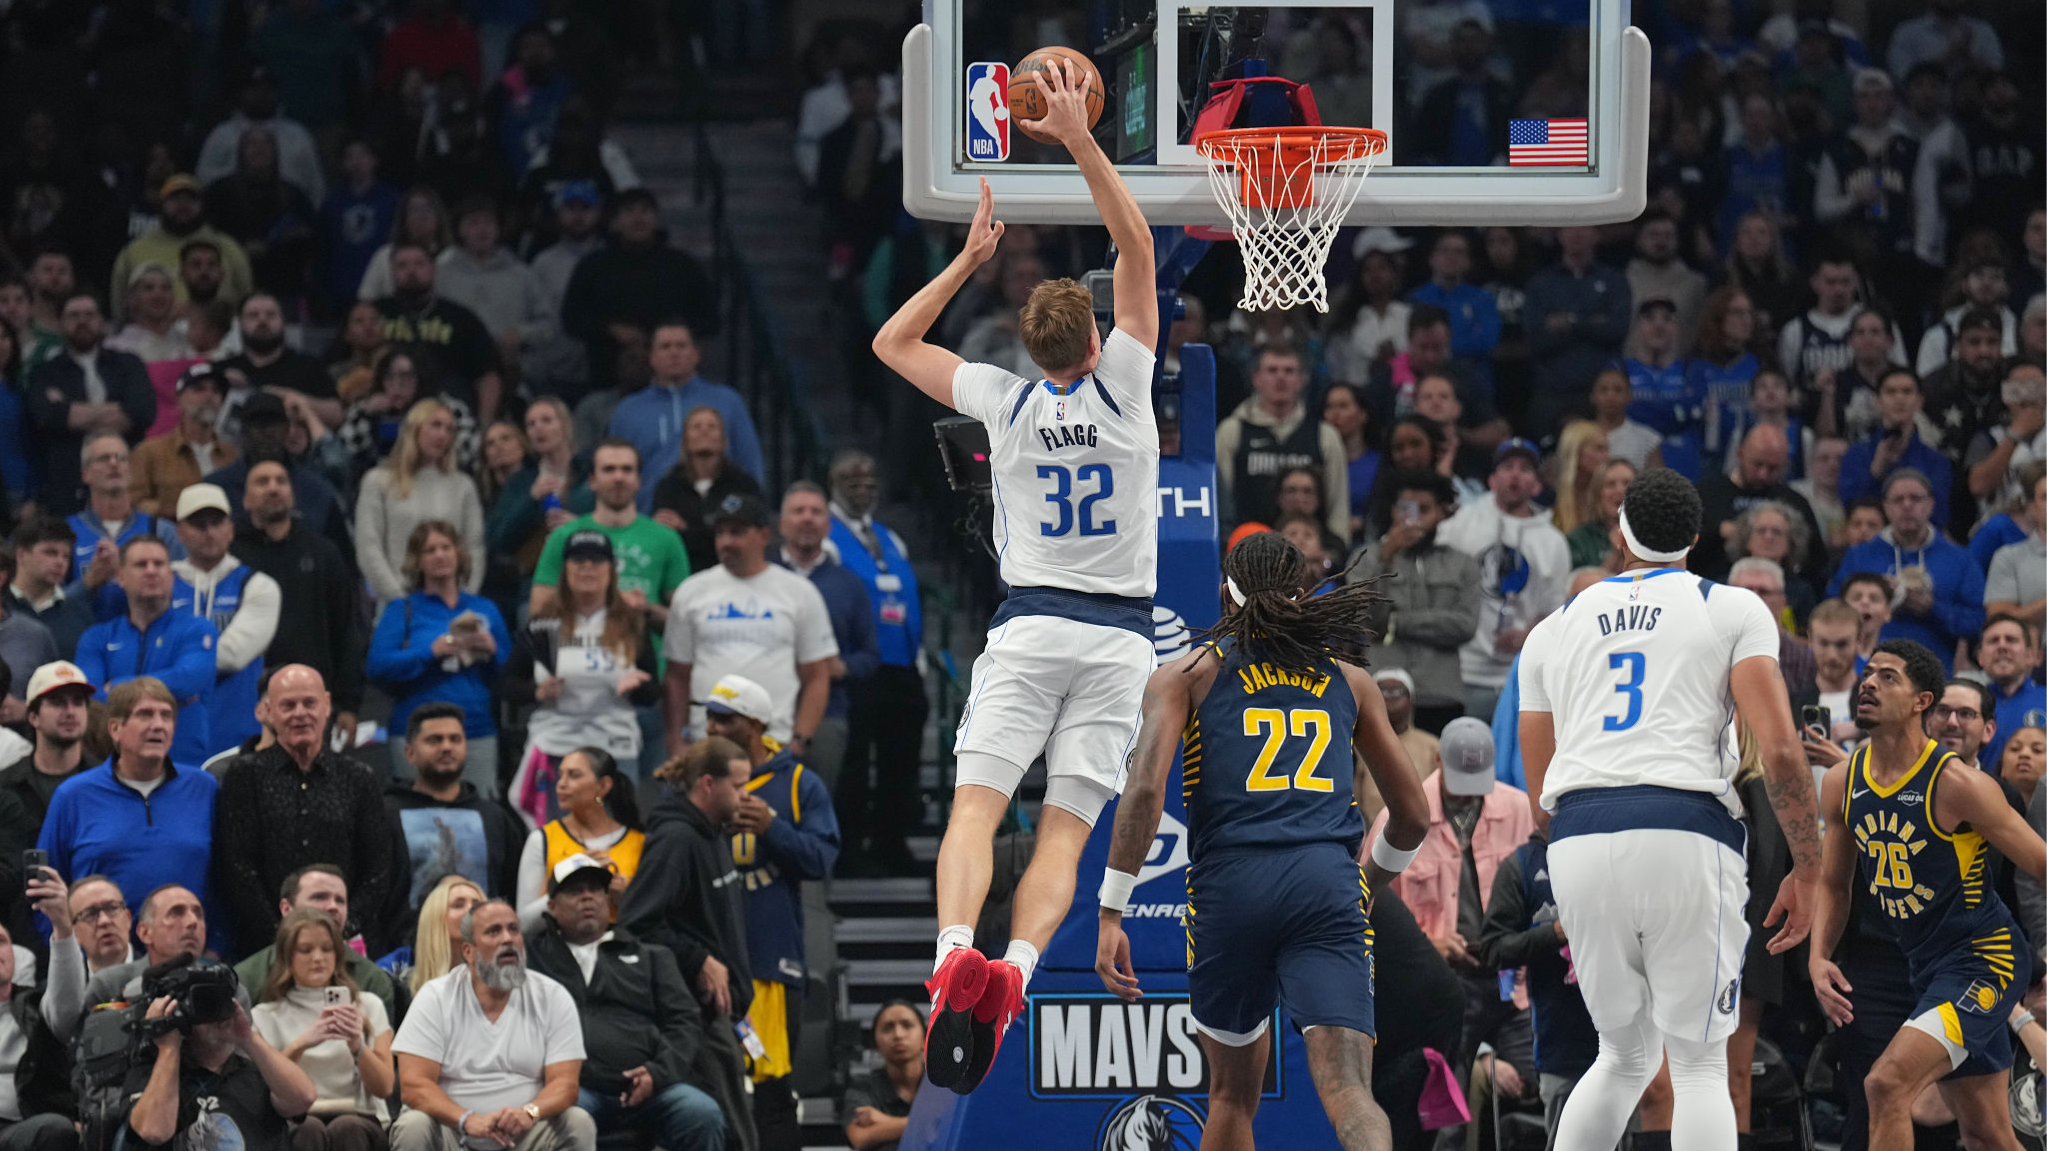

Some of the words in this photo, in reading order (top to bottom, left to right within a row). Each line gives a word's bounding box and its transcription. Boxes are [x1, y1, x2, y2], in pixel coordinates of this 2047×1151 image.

[973, 138, 994, 155] NBA
[1038, 423, 1098, 452] FLAGG
[1036, 463, 1117, 537] 32
[1597, 605, 1662, 636] DAVIS
[1603, 651, 1646, 732] 3
[1243, 707, 1335, 793] 22
[1854, 810, 1928, 856] INDIANA
[1867, 840, 1914, 889] 26
[1040, 1003, 1203, 1089] MAVS
